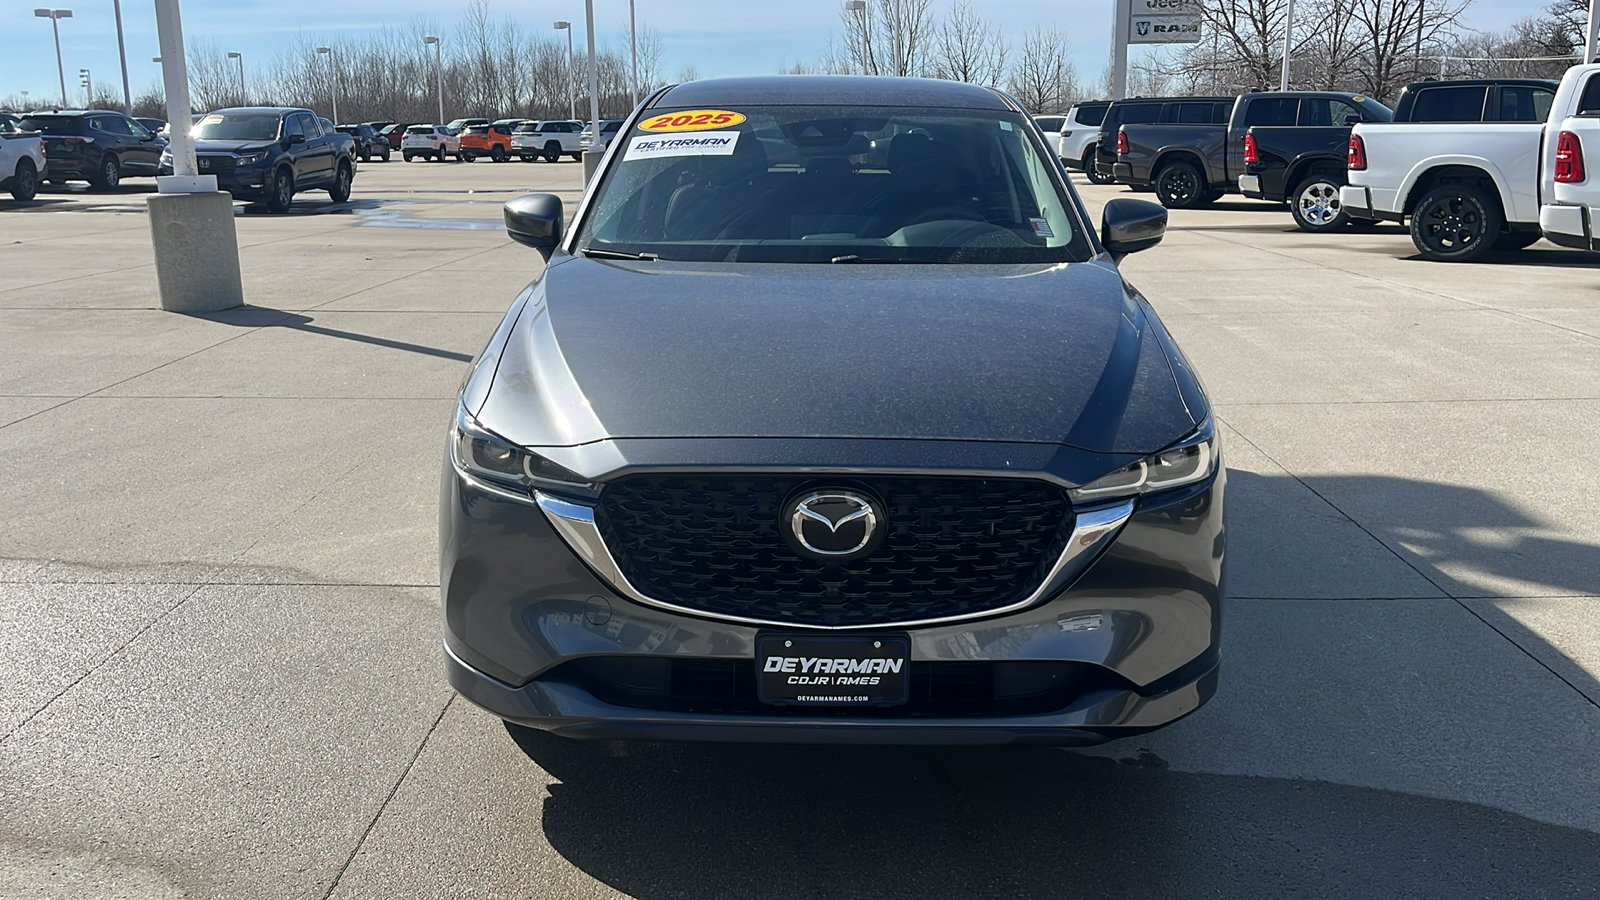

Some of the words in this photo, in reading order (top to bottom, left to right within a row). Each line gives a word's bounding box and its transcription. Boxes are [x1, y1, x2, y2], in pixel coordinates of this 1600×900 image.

[1153, 24, 1199, 33] RAM
[649, 113, 735, 129] 2025
[635, 138, 731, 150] DEYARMAN
[763, 656, 904, 674] DEYARMAN
[836, 676, 881, 685] AMES
